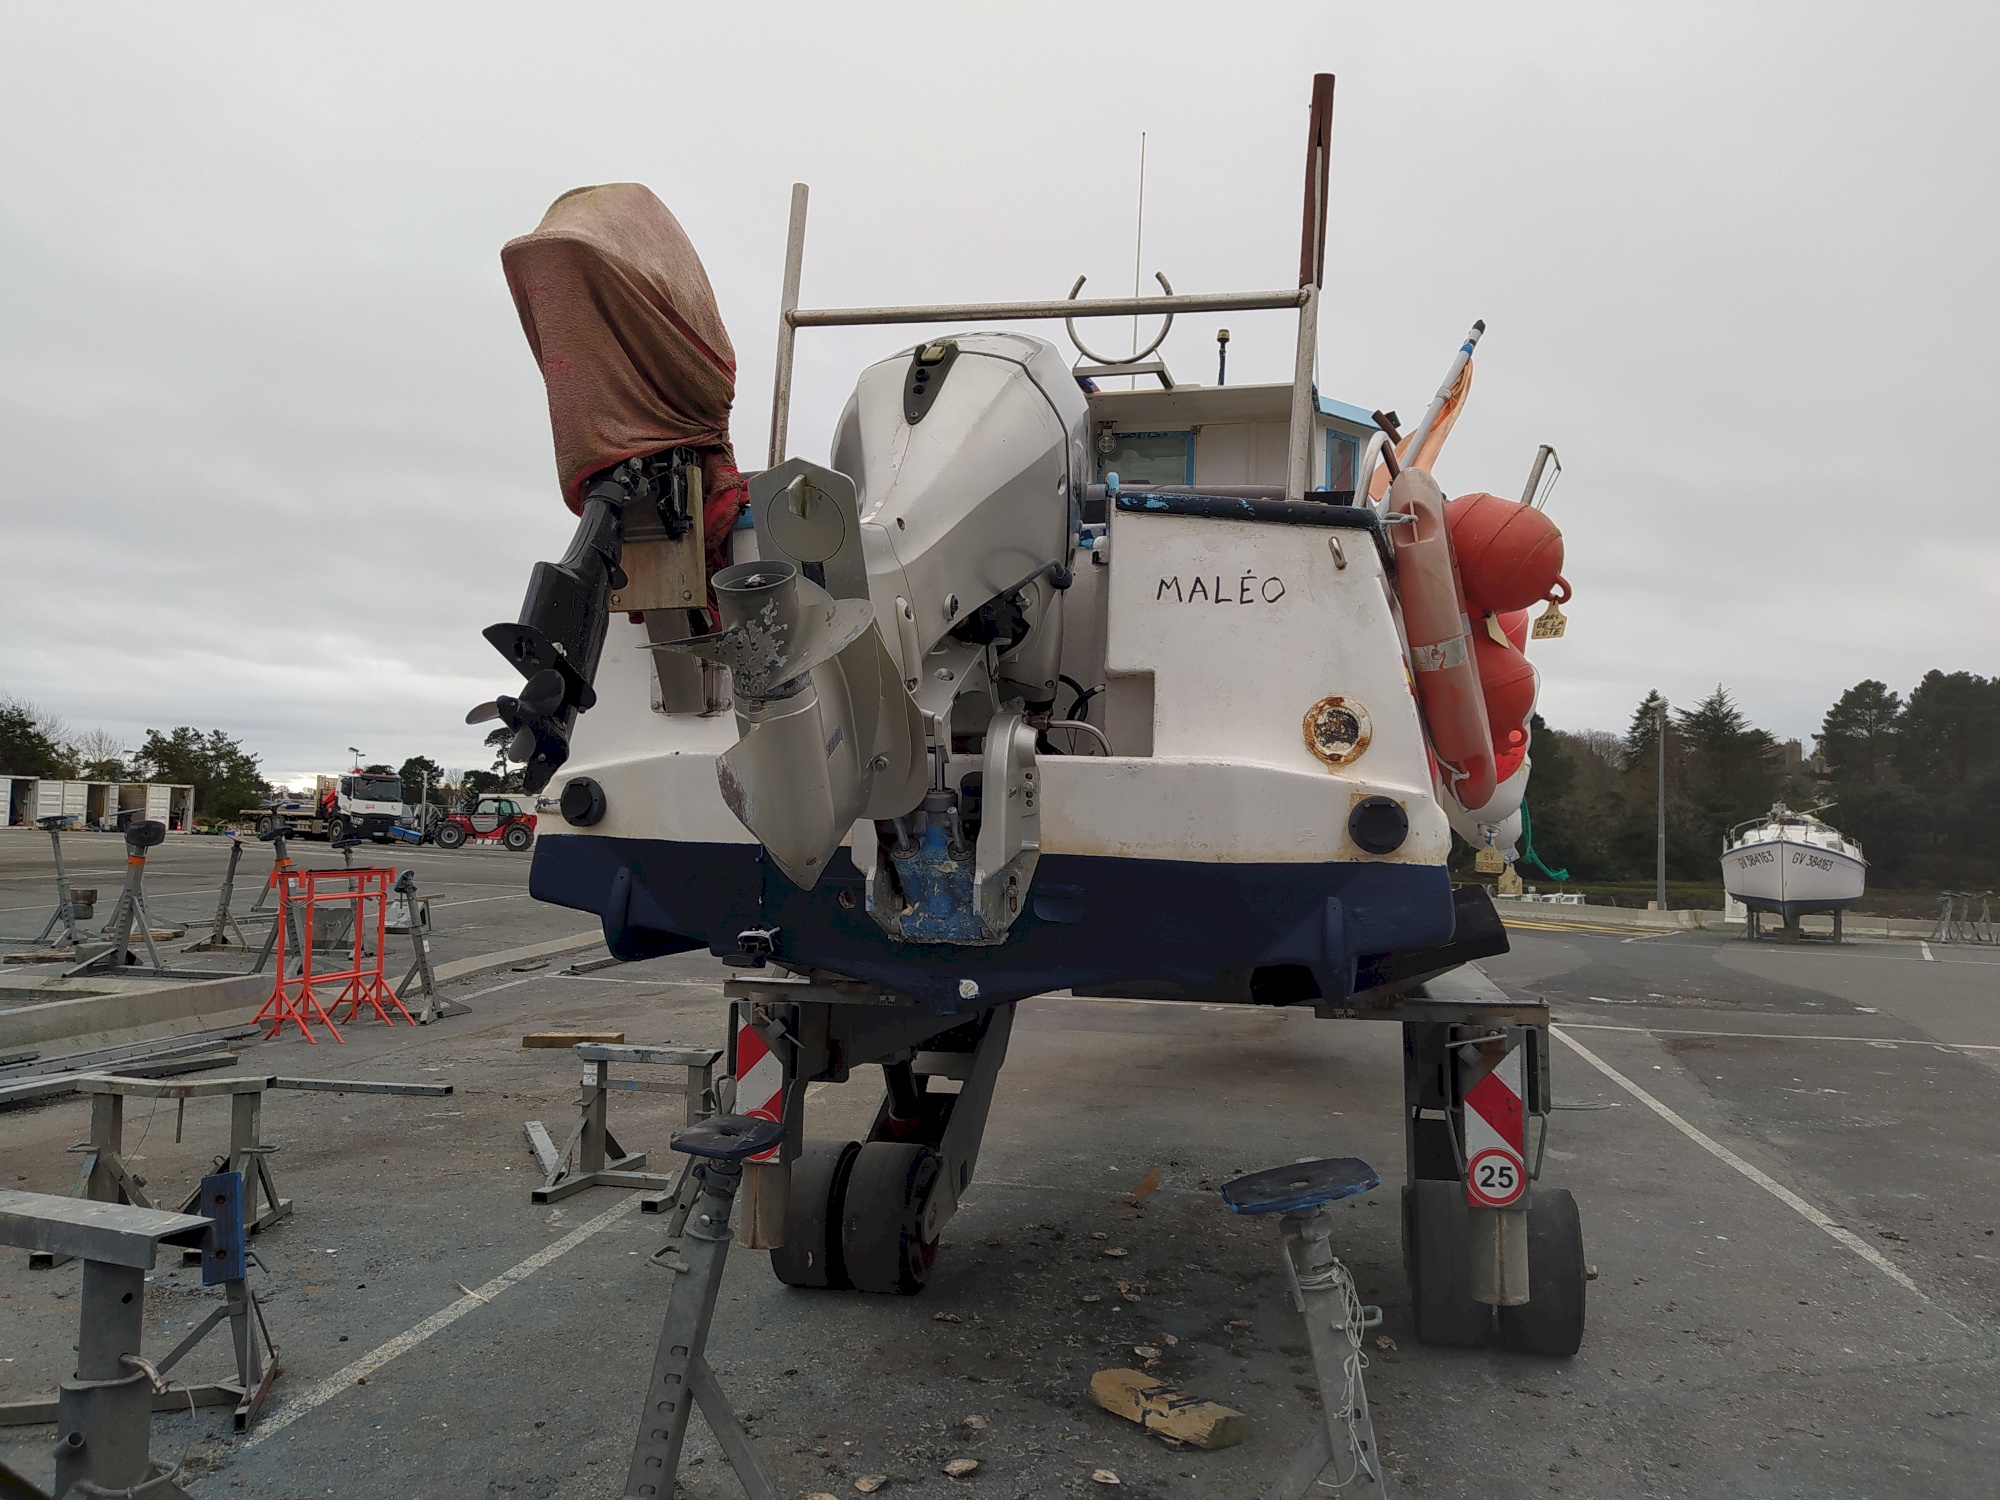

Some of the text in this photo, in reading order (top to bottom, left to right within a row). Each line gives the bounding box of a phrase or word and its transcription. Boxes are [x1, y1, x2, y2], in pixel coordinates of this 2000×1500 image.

[1156, 569, 1286, 604] MALÉO
[1535, 627, 1563, 636] CÔTE
[1551, 620, 1565, 628] LA
[1737, 850, 1775, 869] GV 384163
[1791, 852, 1835, 872] GV 384163
[1479, 1165, 1514, 1189] 25
